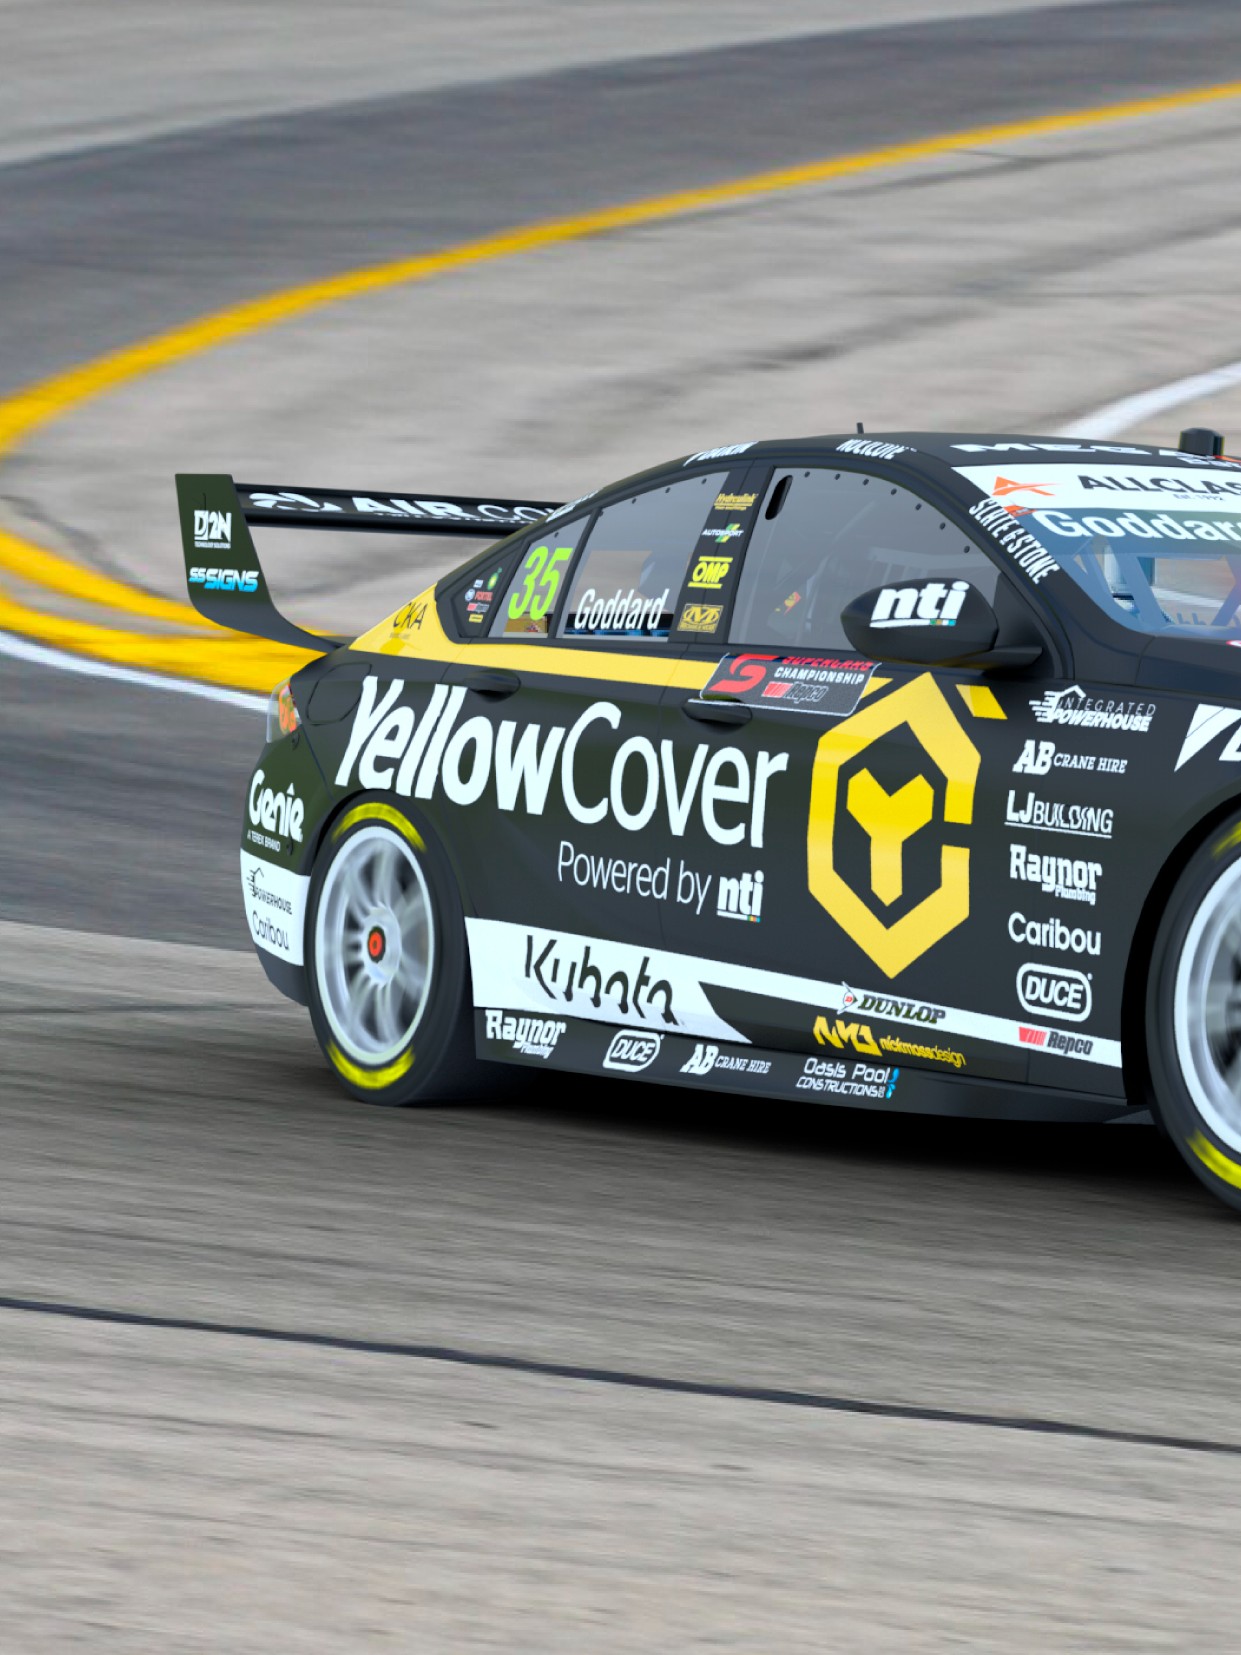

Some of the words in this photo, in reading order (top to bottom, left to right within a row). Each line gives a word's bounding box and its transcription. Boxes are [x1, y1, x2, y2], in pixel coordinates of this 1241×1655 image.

[352, 497, 482, 519] AIR
[692, 561, 730, 583] OMP
[1007, 534, 1060, 585] STONE
[508, 546, 573, 620] 35
[574, 588, 670, 630] Goddard
[871, 580, 970, 621] nti
[773, 666, 865, 685] CHAMPIONSHIP
[1052, 709, 1153, 732] POWERHOUSE
[1012, 739, 1056, 775] AB
[1053, 754, 1101, 770] CRANE
[1097, 757, 1128, 774] HIRE
[249, 769, 305, 842] Genie
[557, 841, 671, 900] Powered
[676, 860, 712, 915] by
[718, 870, 765, 917] nti
[1010, 844, 1103, 892] Raynor
[1008, 912, 1101, 955] Caribou
[1025, 975, 1083, 1009] DUCE
[858, 994, 946, 1025] DUNLOP
[485, 1010, 566, 1048] Raynor
[1047, 1031, 1093, 1055] Repco
[611, 1039, 655, 1062] DUCE
[679, 1043, 719, 1075] AB
[714, 1057, 750, 1071] CRANE
[746, 1061, 772, 1074] HIRE
[796, 1076, 878, 1098] CONSTRUCTIONS
[803, 1057, 846, 1079] Oasis
[852, 1063, 890, 1084] Pool
